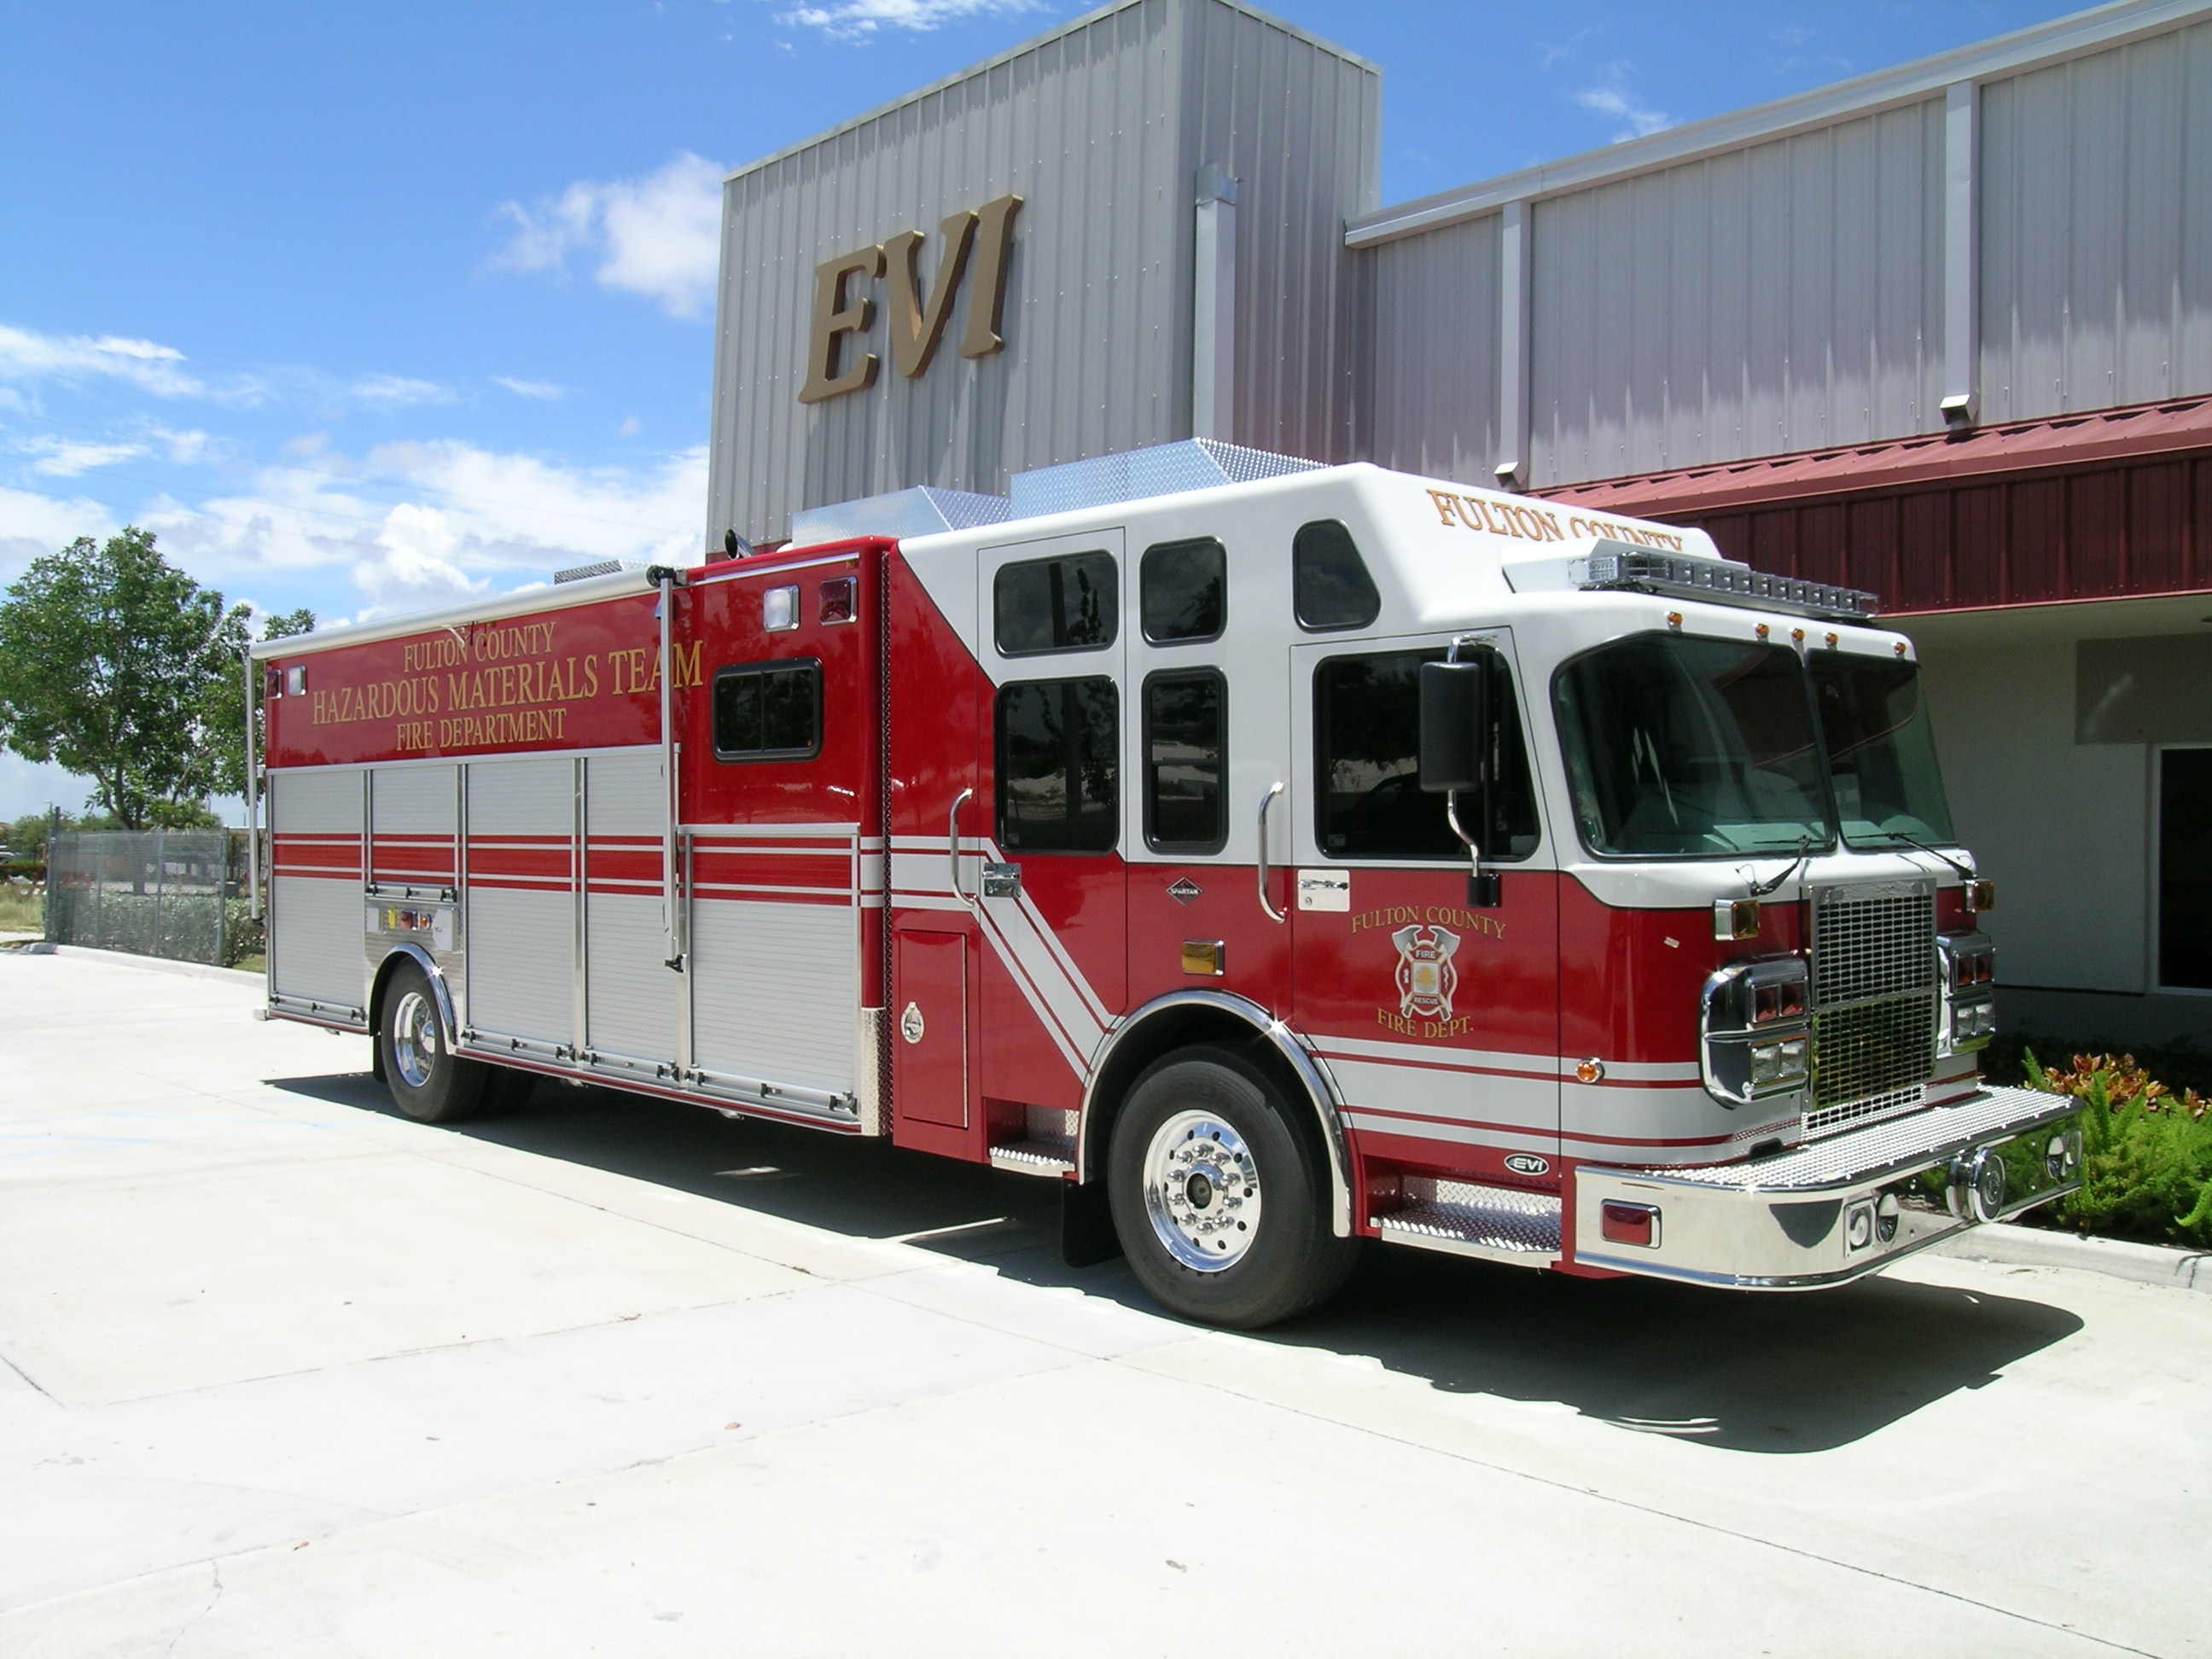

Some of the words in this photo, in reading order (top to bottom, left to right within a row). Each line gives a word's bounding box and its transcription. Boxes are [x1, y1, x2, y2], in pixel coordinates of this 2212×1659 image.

[798, 194, 1024, 405] EVI
[1426, 489, 1564, 542] FULTON
[404, 634, 468, 673] FULTON
[474, 621, 556, 663] COUNTY
[312, 682, 439, 725] HAZARDOUS
[447, 655, 598, 713] MATERIALS
[396, 721, 433, 751] FIRE
[439, 707, 568, 748] DEPARTMENT
[1351, 905, 1419, 934] FULTON
[1426, 905, 1507, 940] COUNTY
[1415, 950, 1436, 959] FIRE
[1413, 996, 1439, 1004] RESCUE
[1377, 1008, 1417, 1037] FIRE
[1423, 1016, 1475, 1039] DEPT.
[1513, 1157, 1543, 1171] EVI
